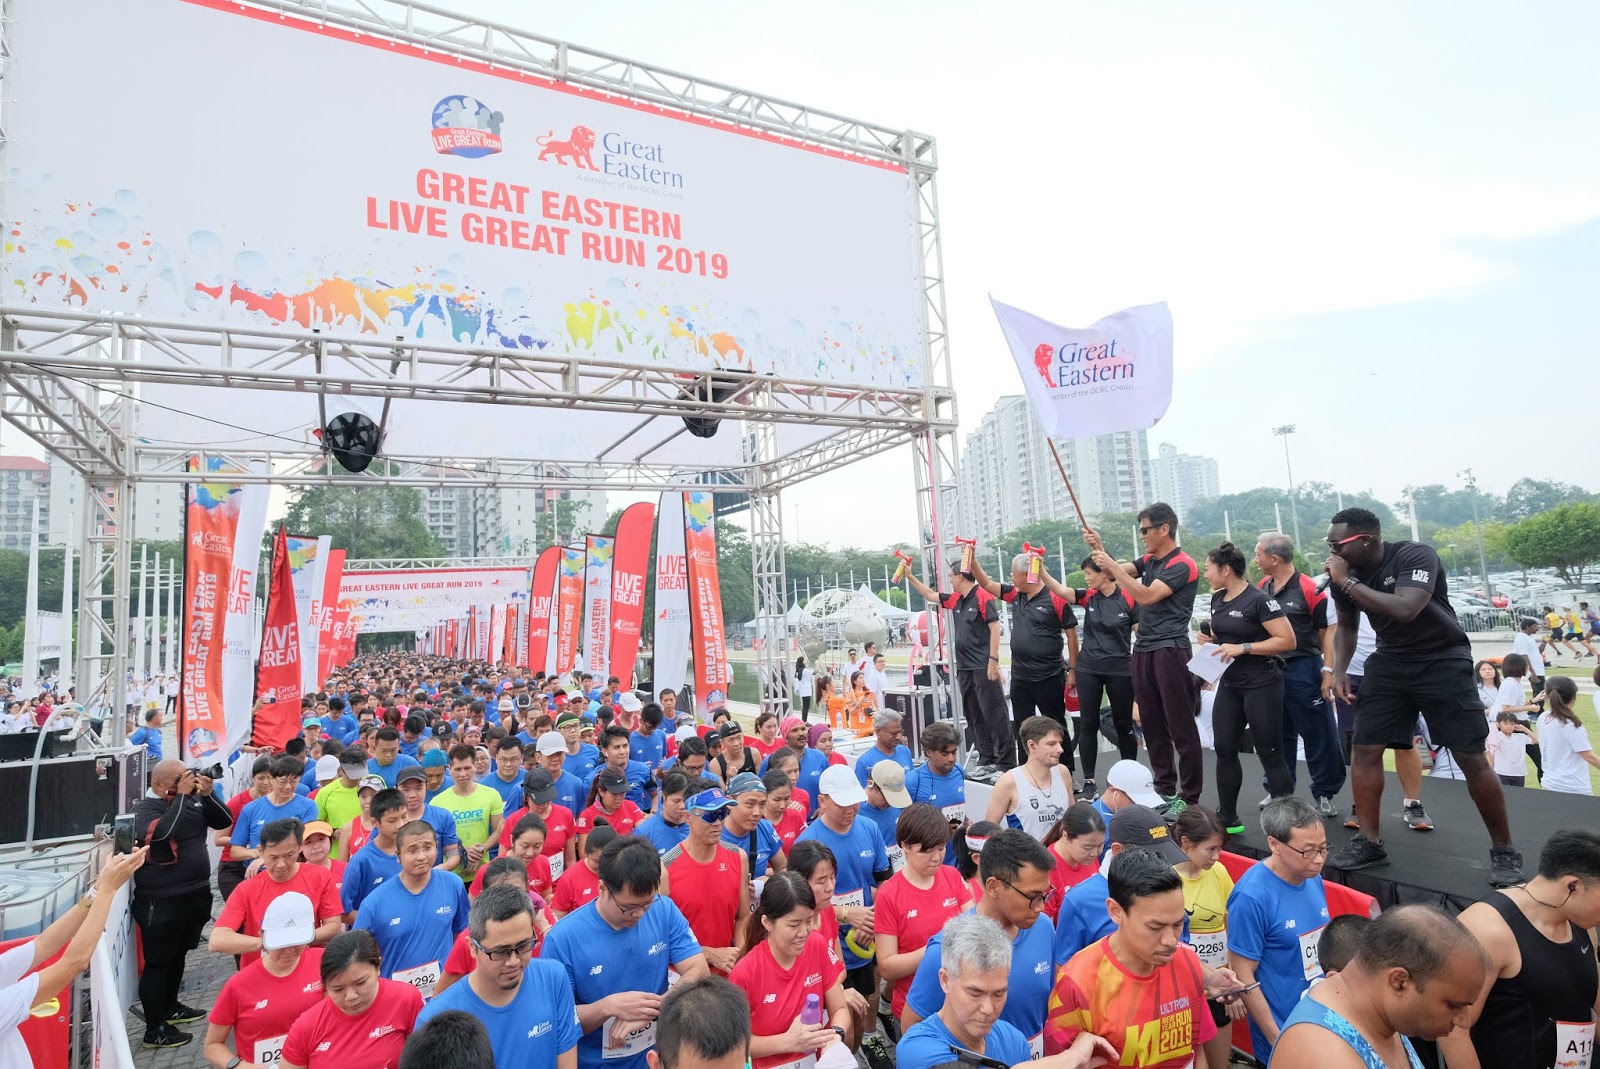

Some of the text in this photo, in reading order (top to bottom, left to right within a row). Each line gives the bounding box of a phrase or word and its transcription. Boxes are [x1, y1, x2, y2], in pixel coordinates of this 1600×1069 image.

[433, 134, 501, 150] LIVE GREAT RUN
[602, 132, 664, 163] Great
[603, 154, 683, 188] Eastern
[584, 176, 615, 188] member
[627, 183, 640, 191] the
[640, 186, 660, 196] OCBC
[662, 190, 685, 200] Group
[416, 168, 682, 240] GREAT EASTERN
[366, 196, 729, 280] LIVE GREAT RUN 2019
[1058, 338, 1118, 364] Great
[1058, 362, 1135, 388] Eastern
[1090, 386, 1109, 394] OCBC
[202, 540, 233, 554] Eastern
[204, 531, 229, 544] Great
[658, 554, 687, 576] LIVE
[1412, 569, 1429, 577] LIVE
[204, 572, 218, 609] 2019
[232, 565, 252, 598] VE
[365, 583, 400, 592] EASTERN
[402, 582, 418, 590] LIVE
[614, 570, 642, 593] LIVE
[658, 576, 687, 590] GREAT
[532, 597, 551, 610] LIV
[614, 588, 642, 606] GREAT
[698, 577, 714, 636] EASTERN
[188, 570, 206, 656] EASTERN
[592, 598, 602, 639] EASTERN
[708, 605, 719, 626] RUN
[202, 611, 214, 640] RUN
[263, 622, 298, 651] LIVE
[598, 634, 606, 656] GREAT
[714, 628, 724, 660] GREAT
[194, 644, 210, 688] GREAT
[704, 640, 717, 684] GREAT
[278, 684, 297, 694] Great
[195, 692, 212, 720] LIVE
[452, 808, 483, 820] Score
[1190, 942, 1224, 954] D2263
[1160, 996, 1190, 1015] ULTRON
[1162, 1008, 1192, 1028] NEW RUN
[1162, 1021, 1176, 1032] YEAR
[1160, 1024, 1192, 1053] 2019
